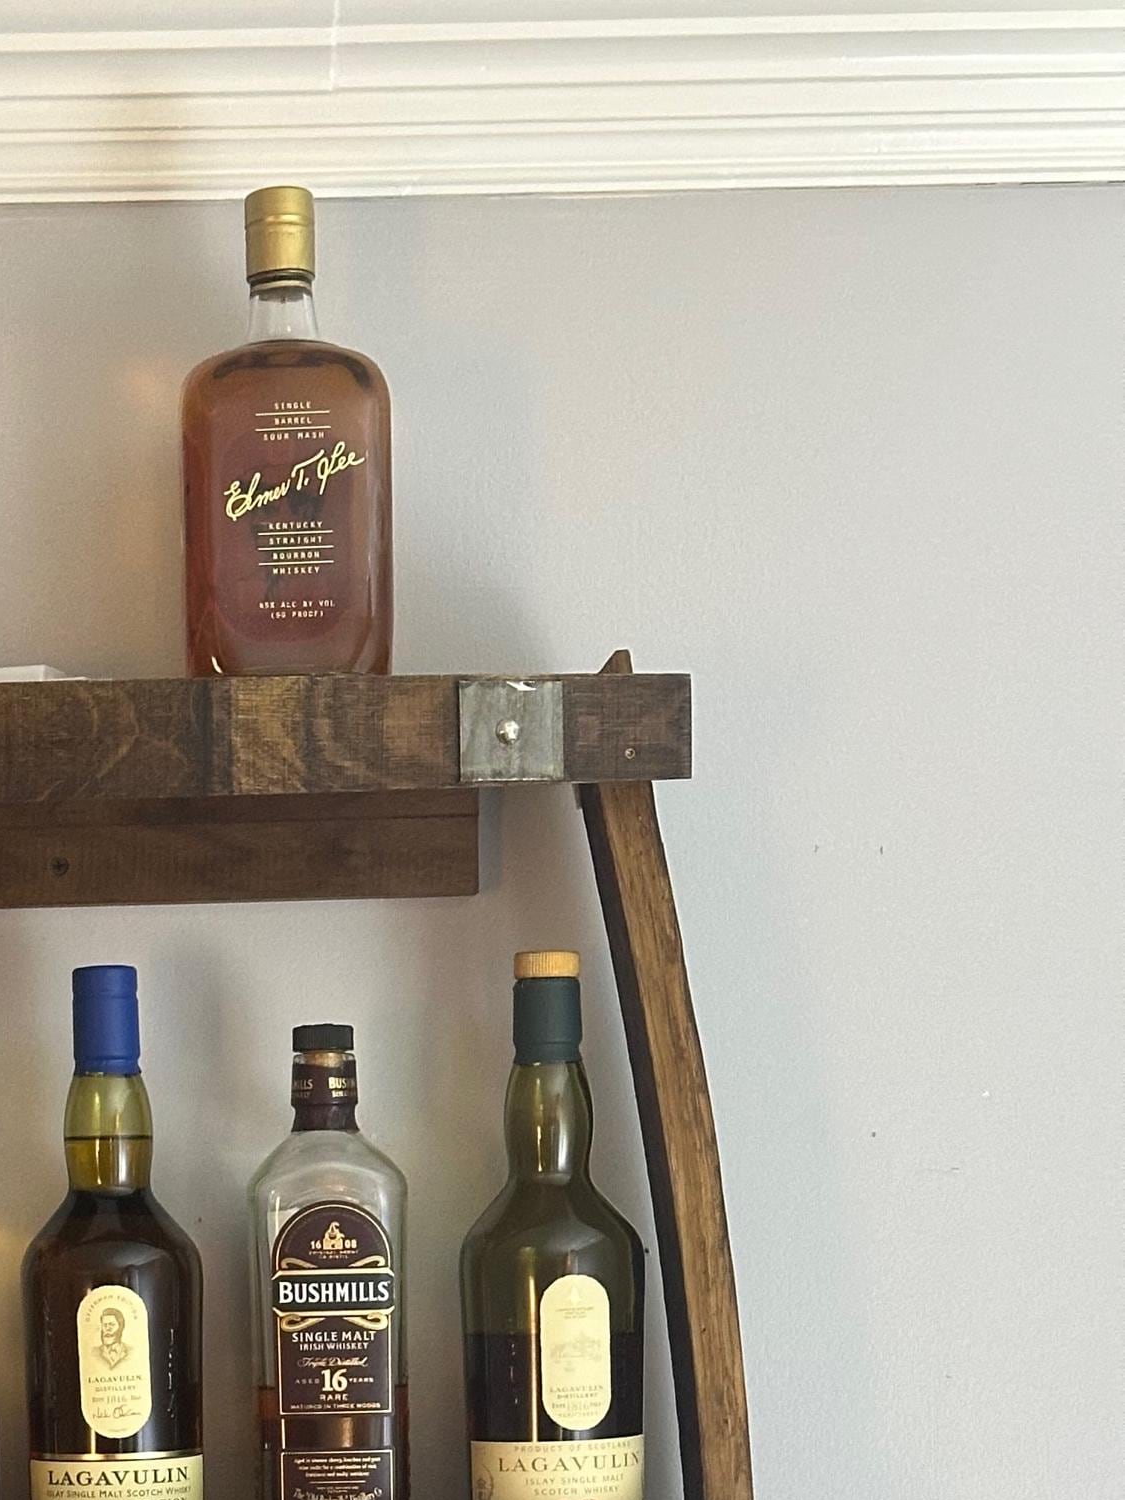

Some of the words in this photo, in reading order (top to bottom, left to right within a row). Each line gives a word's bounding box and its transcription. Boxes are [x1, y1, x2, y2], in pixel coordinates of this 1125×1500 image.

[274, 401, 312, 410] SINGLE
[274, 417, 312, 425] BARREL
[263, 433, 289, 441] SOUR
[297, 431, 325, 440] MASH
[224, 472, 291, 521] Elmer
[268, 521, 323, 530] KENTUCKY
[269, 536, 323, 545] STRAIGHT
[272, 551, 320, 560] BOURBON
[272, 566, 320, 575] WHISKEY
[310, 1240, 321, 1249] 16
[344, 1239, 357, 1249] 08
[278, 1281, 389, 1304] BUSHMILLS
[291, 1332, 338, 1343] SINGLE
[341, 1331, 377, 1341] MALT
[299, 1343, 324, 1351] IRISH
[326, 1342, 369, 1350] WHISKEY
[88, 1375, 142, 1384] LAGAVULIN
[321, 1368, 348, 1392] 16
[319, 1393, 348, 1401] RARE
[515, 1445, 563, 1453] PRODUCT
[498, 1451, 640, 1472] LAGAVULIN
[47, 1466, 189, 1486] LAGAVULIN
[525, 1478, 554, 1486] ISLAY
[561, 1476, 596, 1484] SINGLE
[603, 1474, 625, 1482] MALT
[67, 1490, 95, 1498] SINGLE
[99, 1490, 123, 1498] MALT
[127, 1489, 162, 1498] SCOTCH
[534, 1488, 578, 1496] SCOTCH
[584, 1486, 619, 1494] WHISKY
